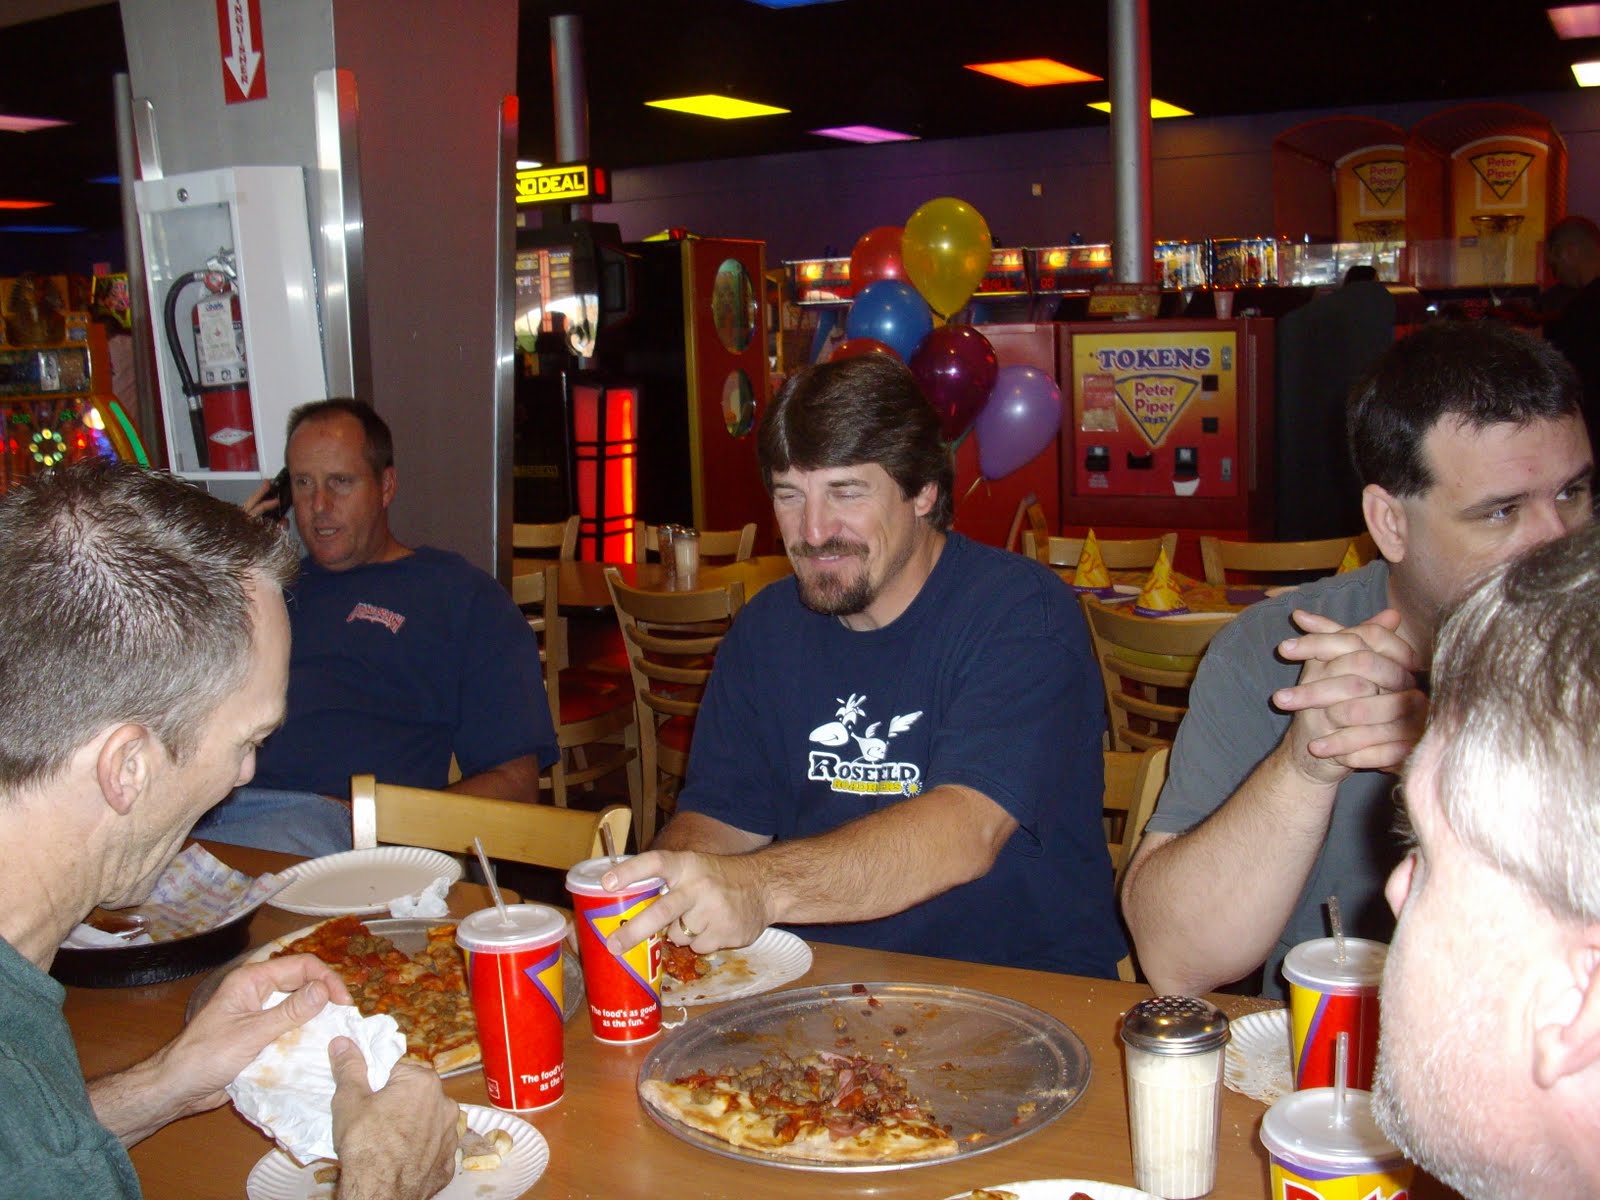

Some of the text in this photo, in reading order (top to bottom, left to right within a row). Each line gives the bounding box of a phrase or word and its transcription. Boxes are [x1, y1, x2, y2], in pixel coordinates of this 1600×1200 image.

[538, 173, 584, 194] DEAL
[1098, 348, 1212, 370] TOKENS
[1135, 382, 1174, 396] Peter
[1135, 398, 1175, 415] Piper
[591, 1005, 602, 1016] The
[602, 1008, 628, 1018] food's
[640, 1002, 657, 1018] good
[602, 1018, 644, 1028] as the fun.
[520, 1074, 540, 1085] The
[540, 1077, 560, 1092] as the
